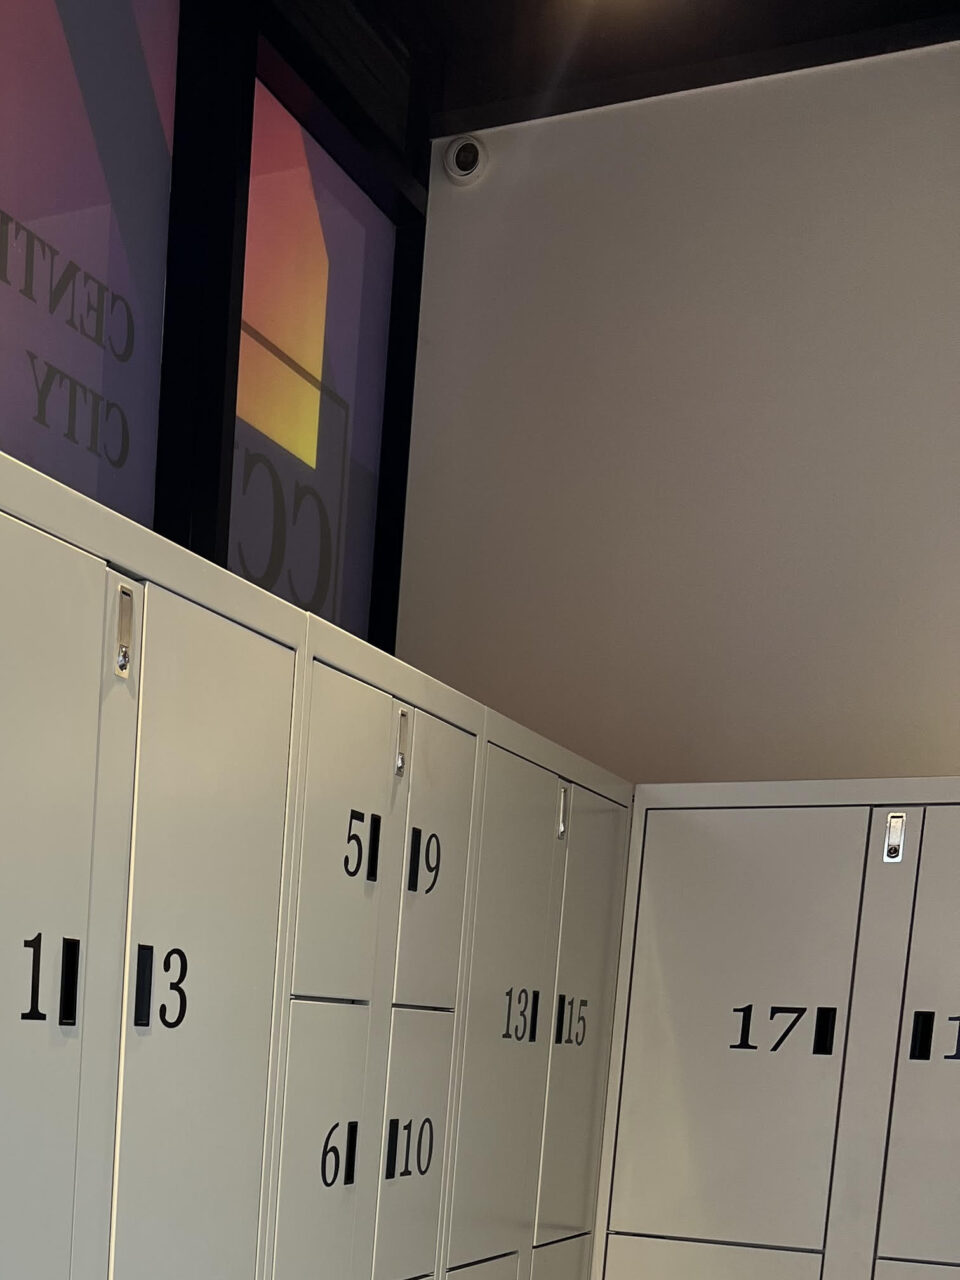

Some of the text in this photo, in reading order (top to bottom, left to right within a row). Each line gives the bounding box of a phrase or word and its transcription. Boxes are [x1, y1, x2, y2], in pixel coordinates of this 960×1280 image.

[344, 809, 365, 877] 5
[425, 833, 441, 895] 9
[20, 932, 47, 1021] 1
[159, 948, 188, 1029] 3
[502, 986, 529, 1041] 13
[565, 997, 588, 1046] 15
[729, 1004, 808, 1052] 17
[321, 1122, 340, 1187] 6
[399, 1117, 434, 1177] 10
